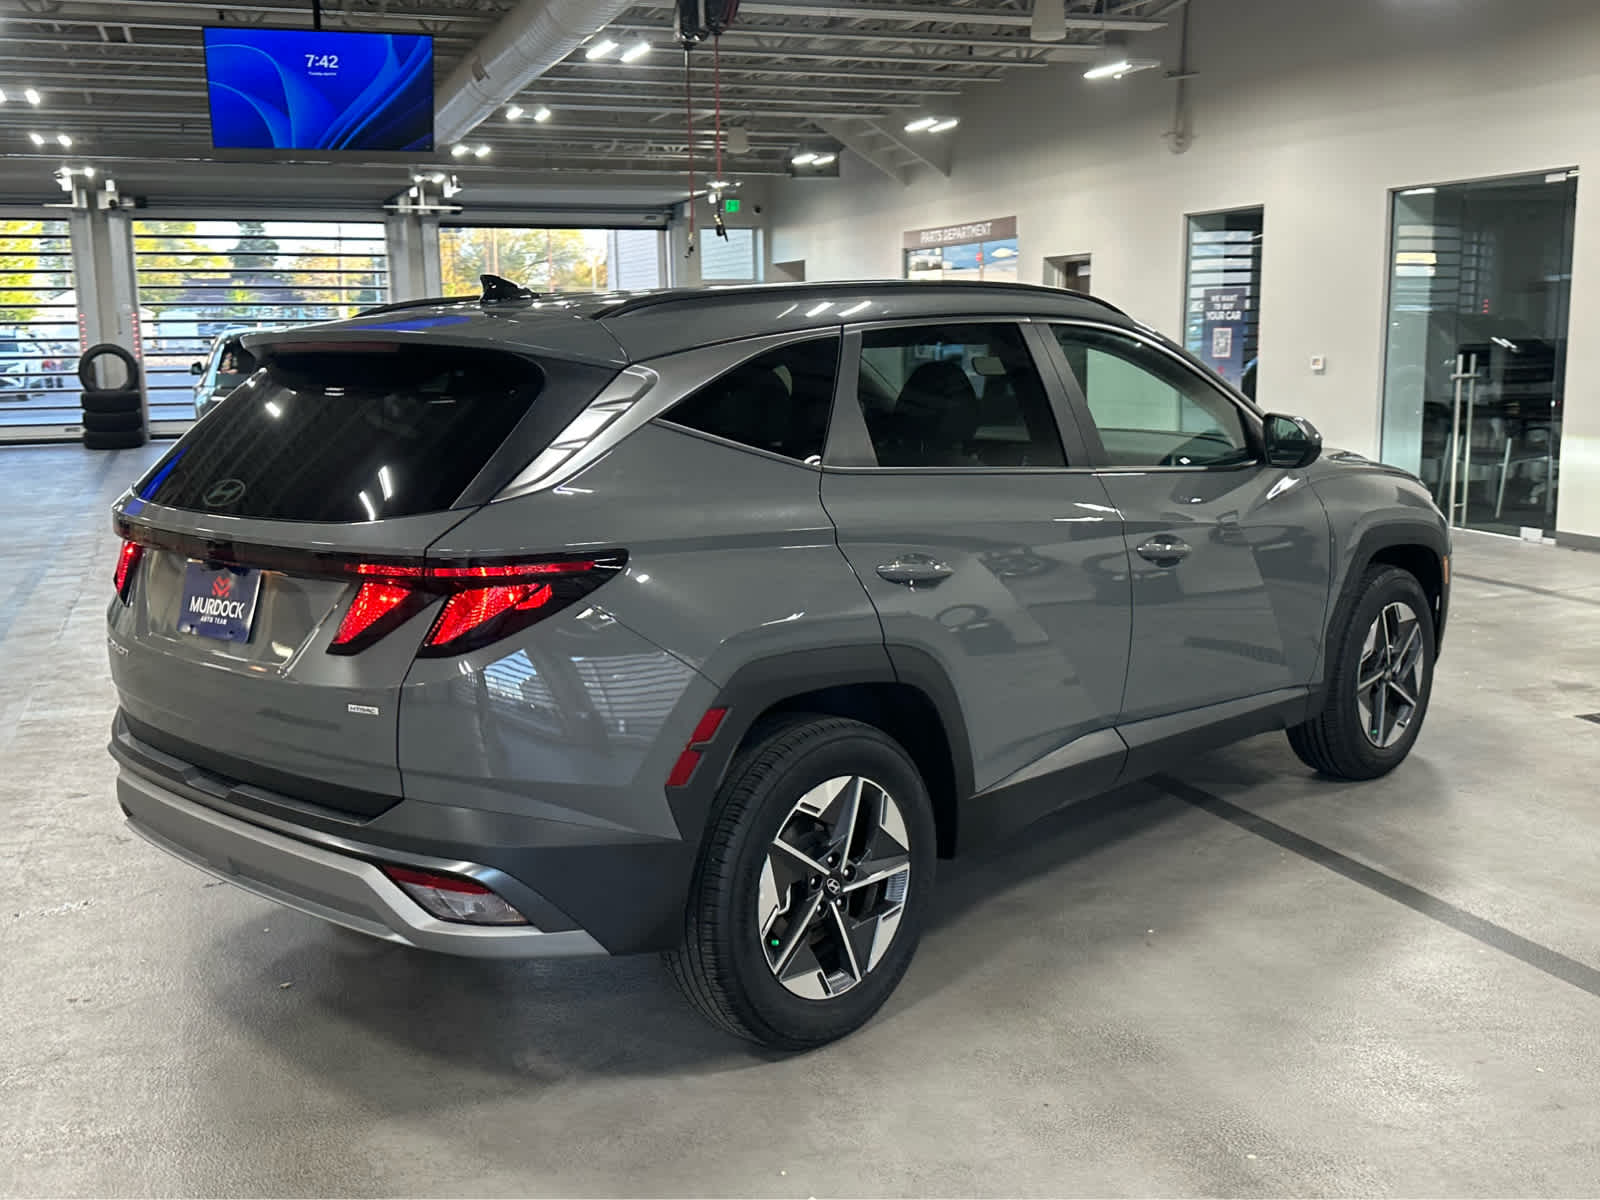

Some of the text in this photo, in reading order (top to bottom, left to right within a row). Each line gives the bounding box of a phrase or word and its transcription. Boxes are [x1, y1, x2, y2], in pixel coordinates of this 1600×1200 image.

[305, 54, 339, 68] 7:42
[920, 222, 992, 243] PARTS DEPARTMENT
[1206, 311, 1241, 320] YOUR CAR
[189, 596, 245, 619] MURDOCK
[200, 615, 228, 625] AUTO TEAM
